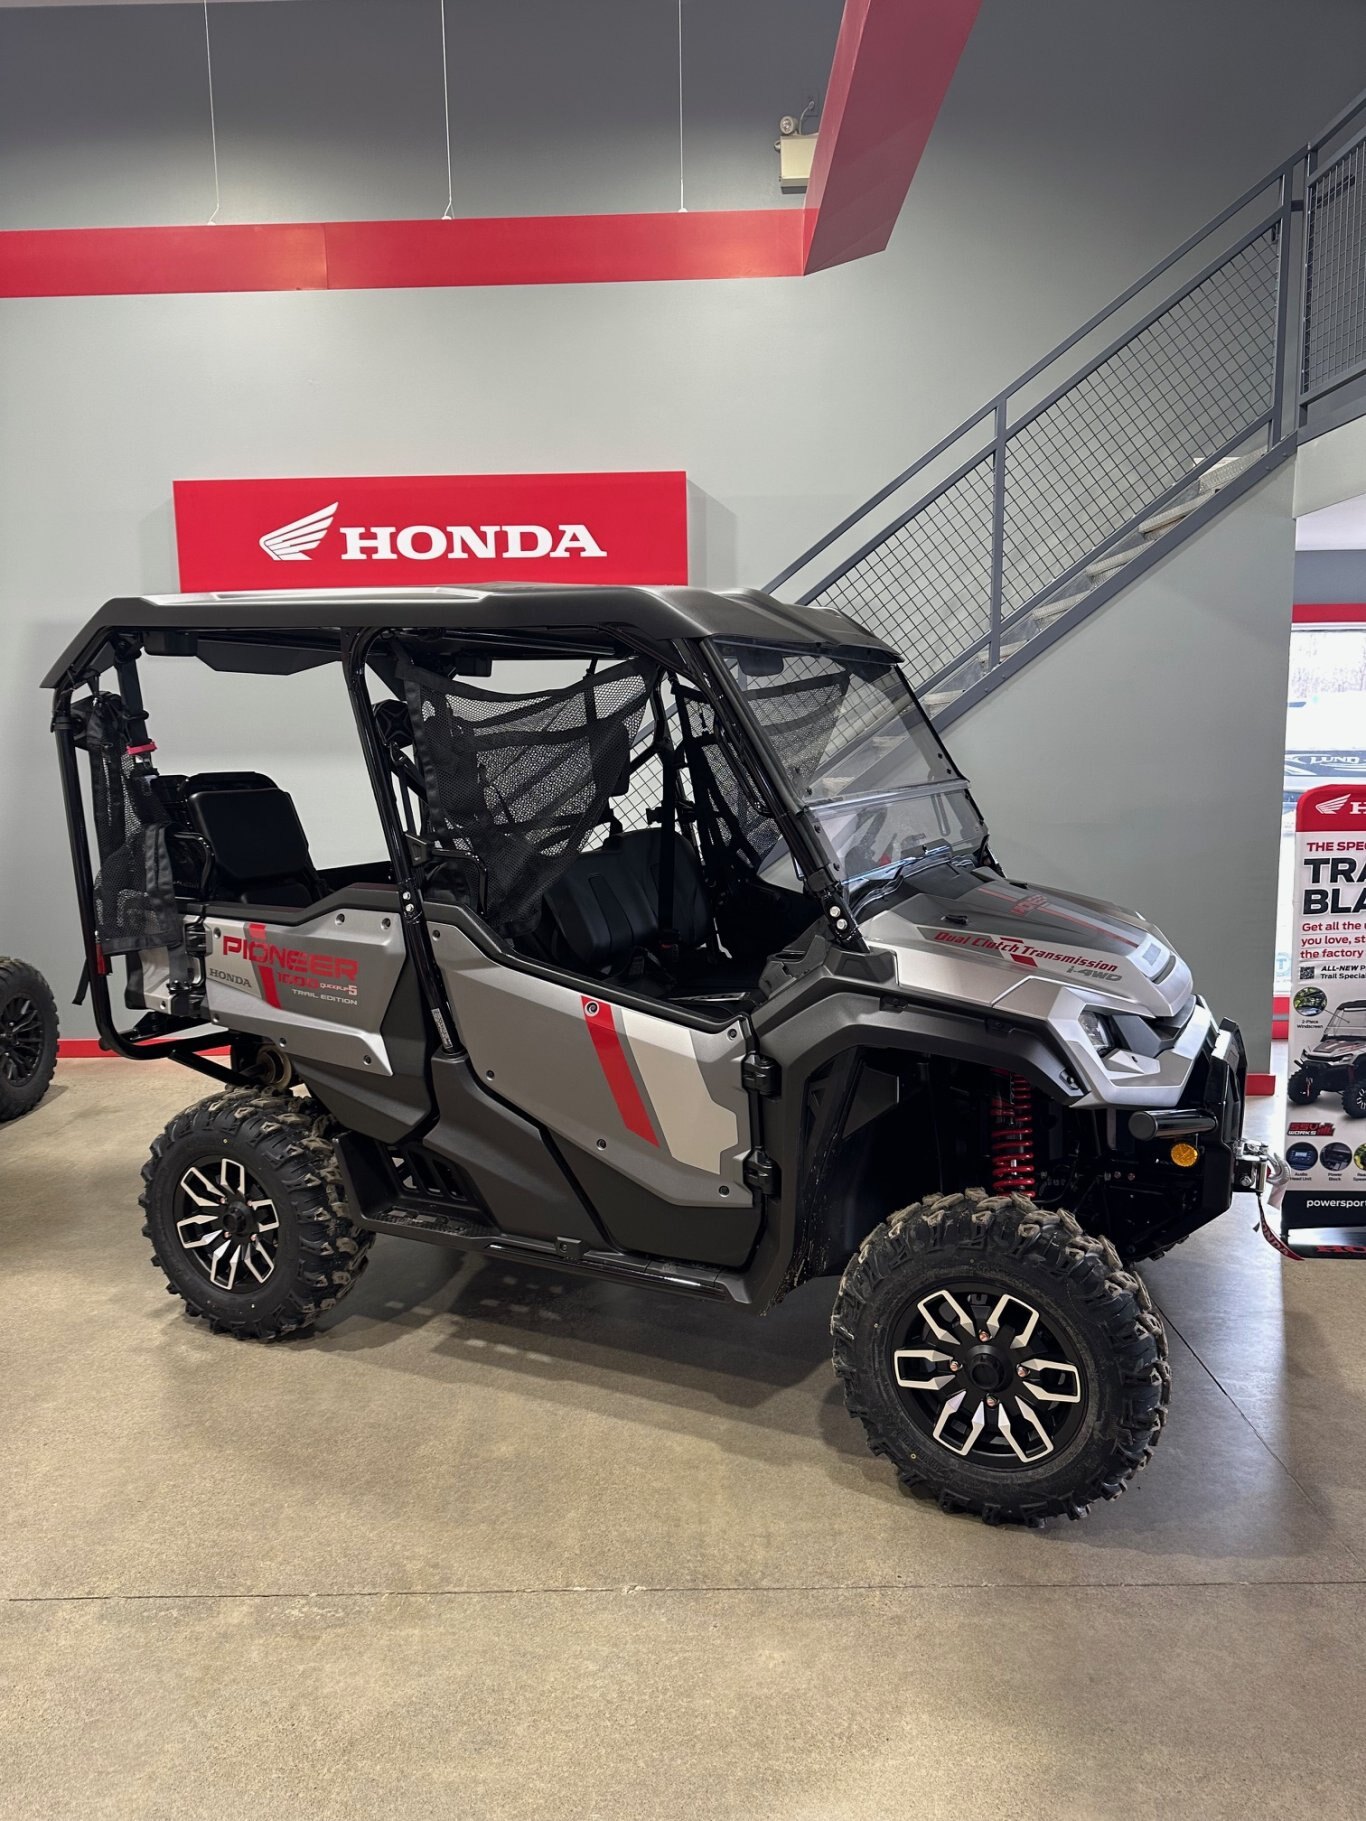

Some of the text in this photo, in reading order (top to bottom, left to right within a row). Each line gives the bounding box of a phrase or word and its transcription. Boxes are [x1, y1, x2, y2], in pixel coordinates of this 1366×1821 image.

[340, 524, 607, 560] HONDA
[1309, 756, 1360, 765] LUND
[1306, 842, 1334, 852] THE
[1302, 921, 1362, 932] Get all the
[1301, 937, 1322, 947] you
[1325, 935, 1352, 946] love,
[222, 935, 359, 981] PIONEER
[933, 931, 1118, 973] Dual Clutch Transmission
[1300, 948, 1364, 959] the factory
[209, 967, 252, 988] HONDA
[1066, 965, 1123, 982] i-4WD
[292, 988, 358, 1006] TRAIL EDITION
